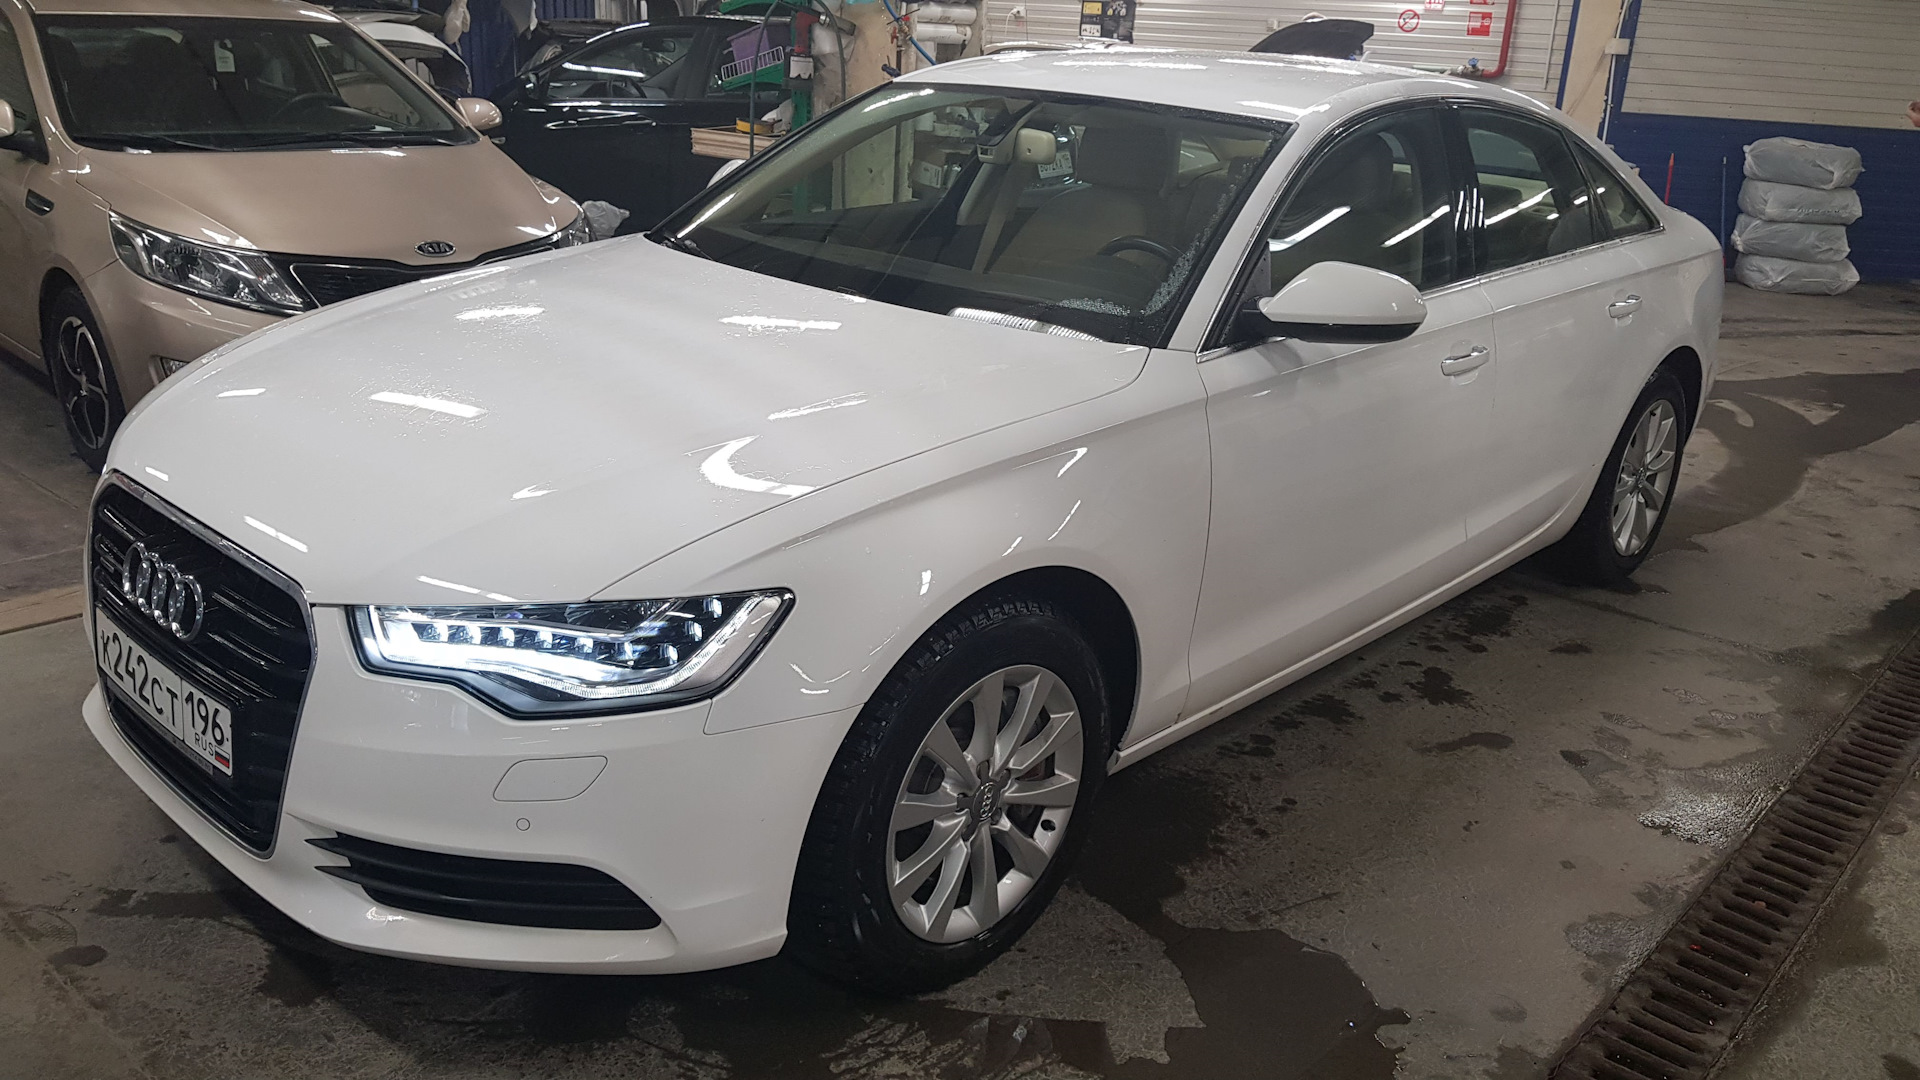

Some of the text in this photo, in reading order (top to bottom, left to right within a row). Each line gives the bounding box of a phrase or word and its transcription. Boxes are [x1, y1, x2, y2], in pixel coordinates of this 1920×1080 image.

[420, 243, 450, 253] KIA
[185, 691, 225, 746] 196
[194, 733, 214, 757] RUS
